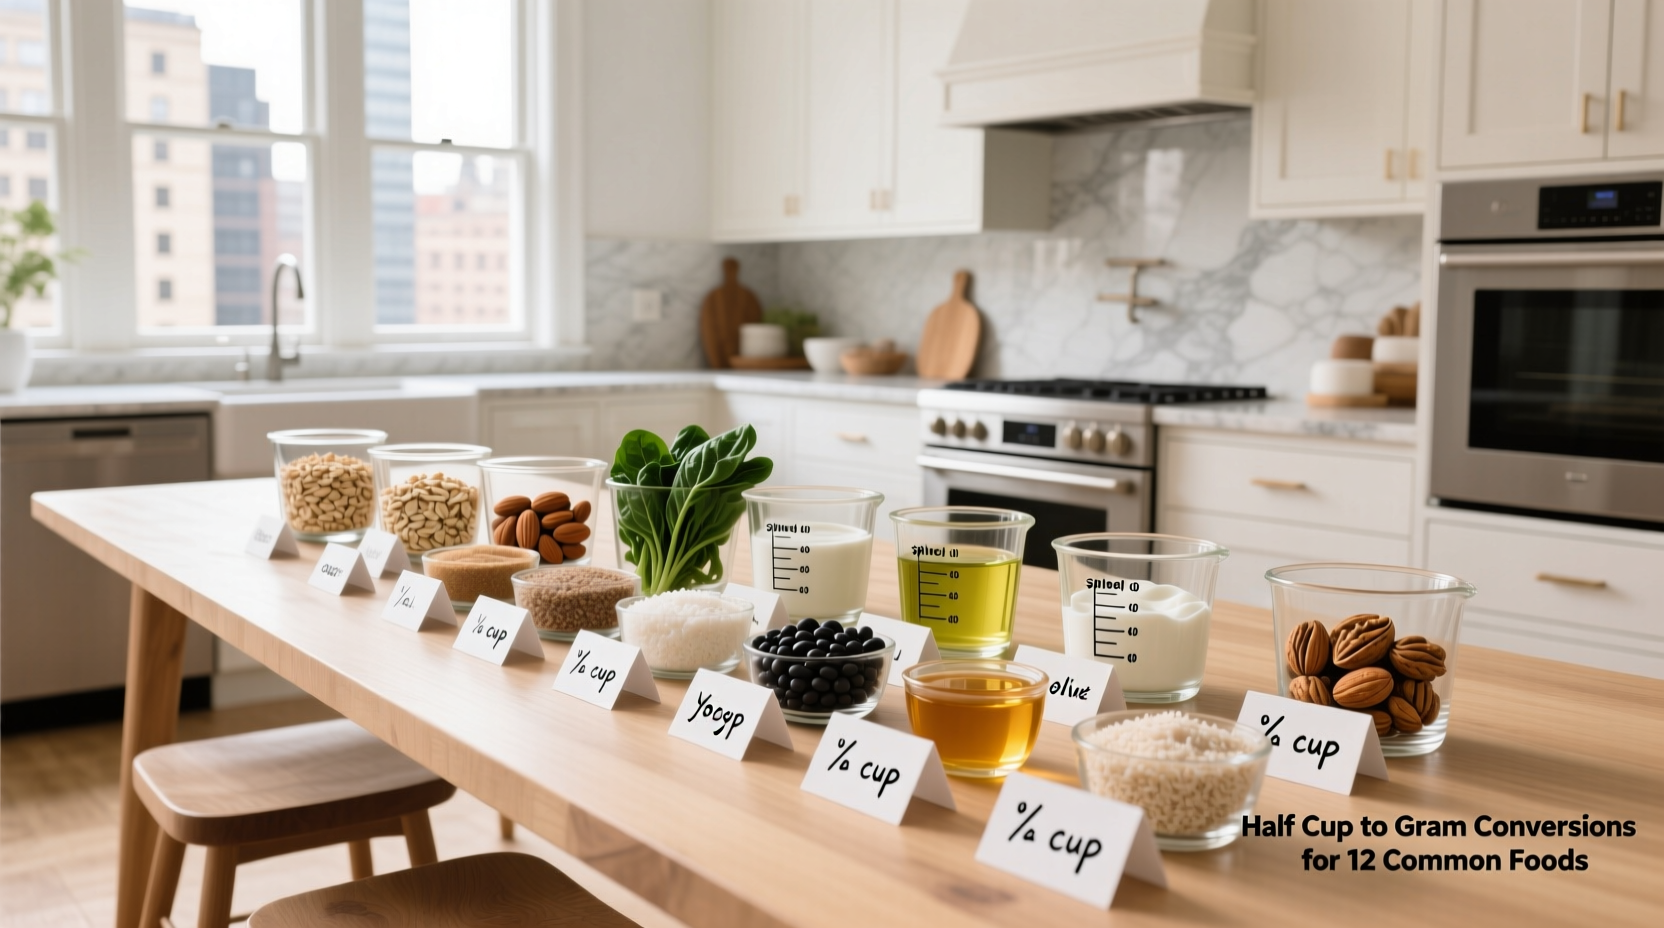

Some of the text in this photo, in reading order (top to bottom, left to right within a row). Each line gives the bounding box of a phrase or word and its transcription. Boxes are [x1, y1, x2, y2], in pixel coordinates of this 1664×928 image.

[486, 626, 508, 650] cup
[590, 665, 617, 693] cup
[1292, 735, 1340, 770] cup
[860, 761, 902, 799] cup
[1049, 830, 1103, 874] cup
